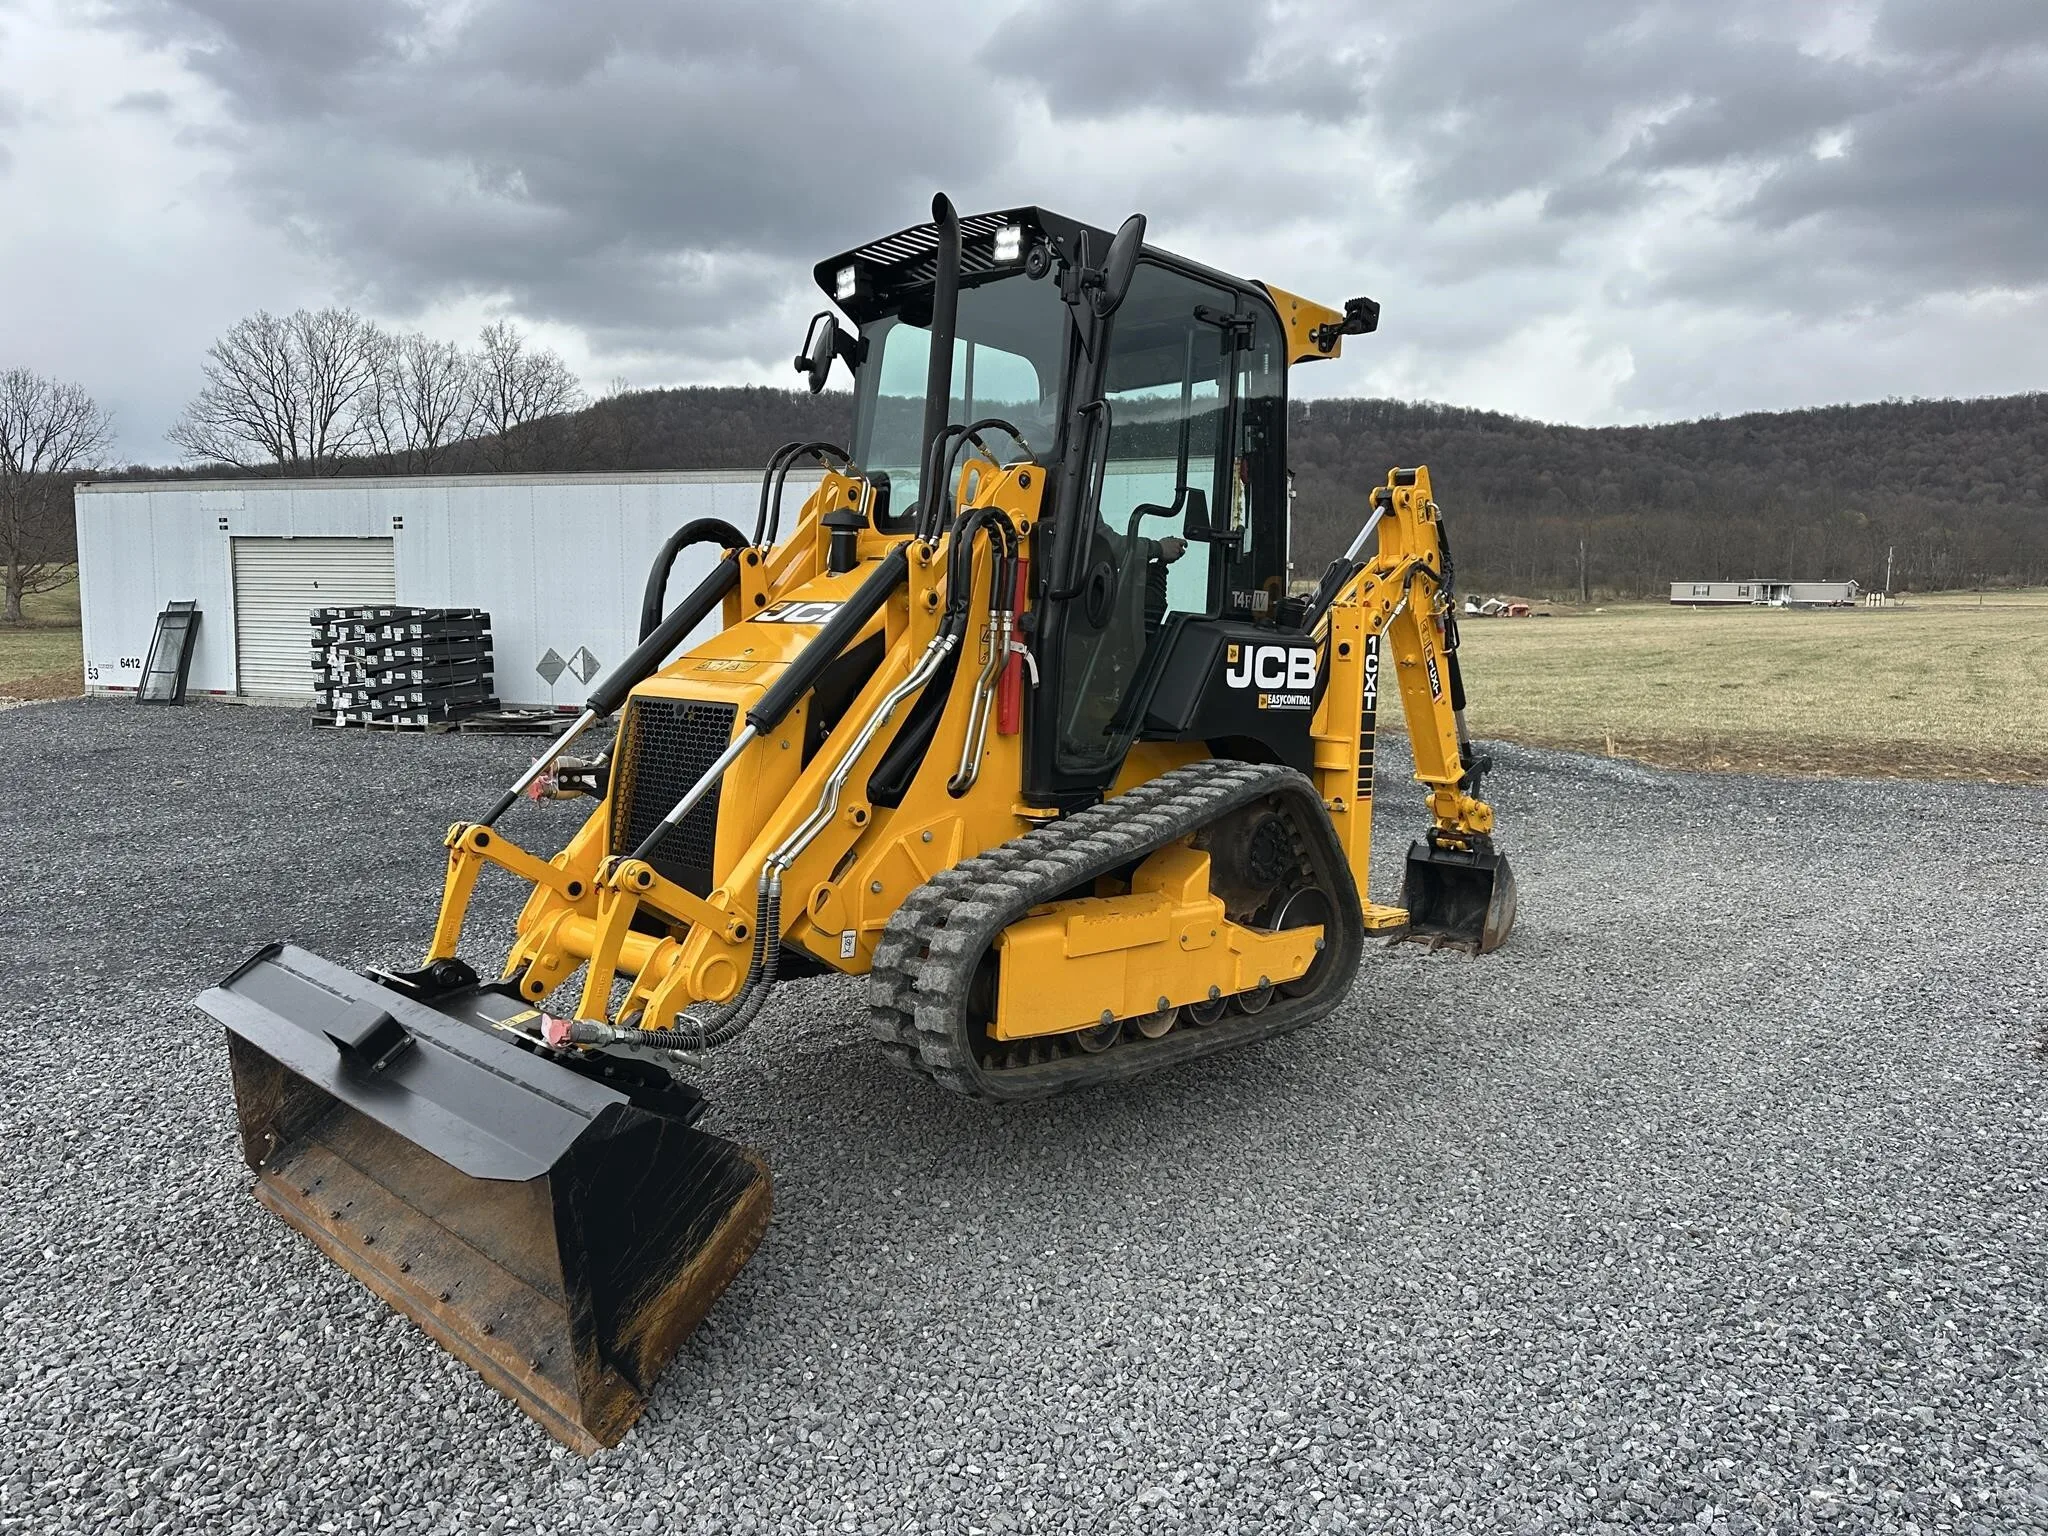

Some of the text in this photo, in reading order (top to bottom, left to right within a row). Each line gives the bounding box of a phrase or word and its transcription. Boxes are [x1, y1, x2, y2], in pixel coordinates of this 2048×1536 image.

[88, 667, 99, 680] 53
[120, 657, 141, 669] 6412
[1226, 645, 1317, 689] JCB
[1363, 635, 1379, 710] 1CXT
